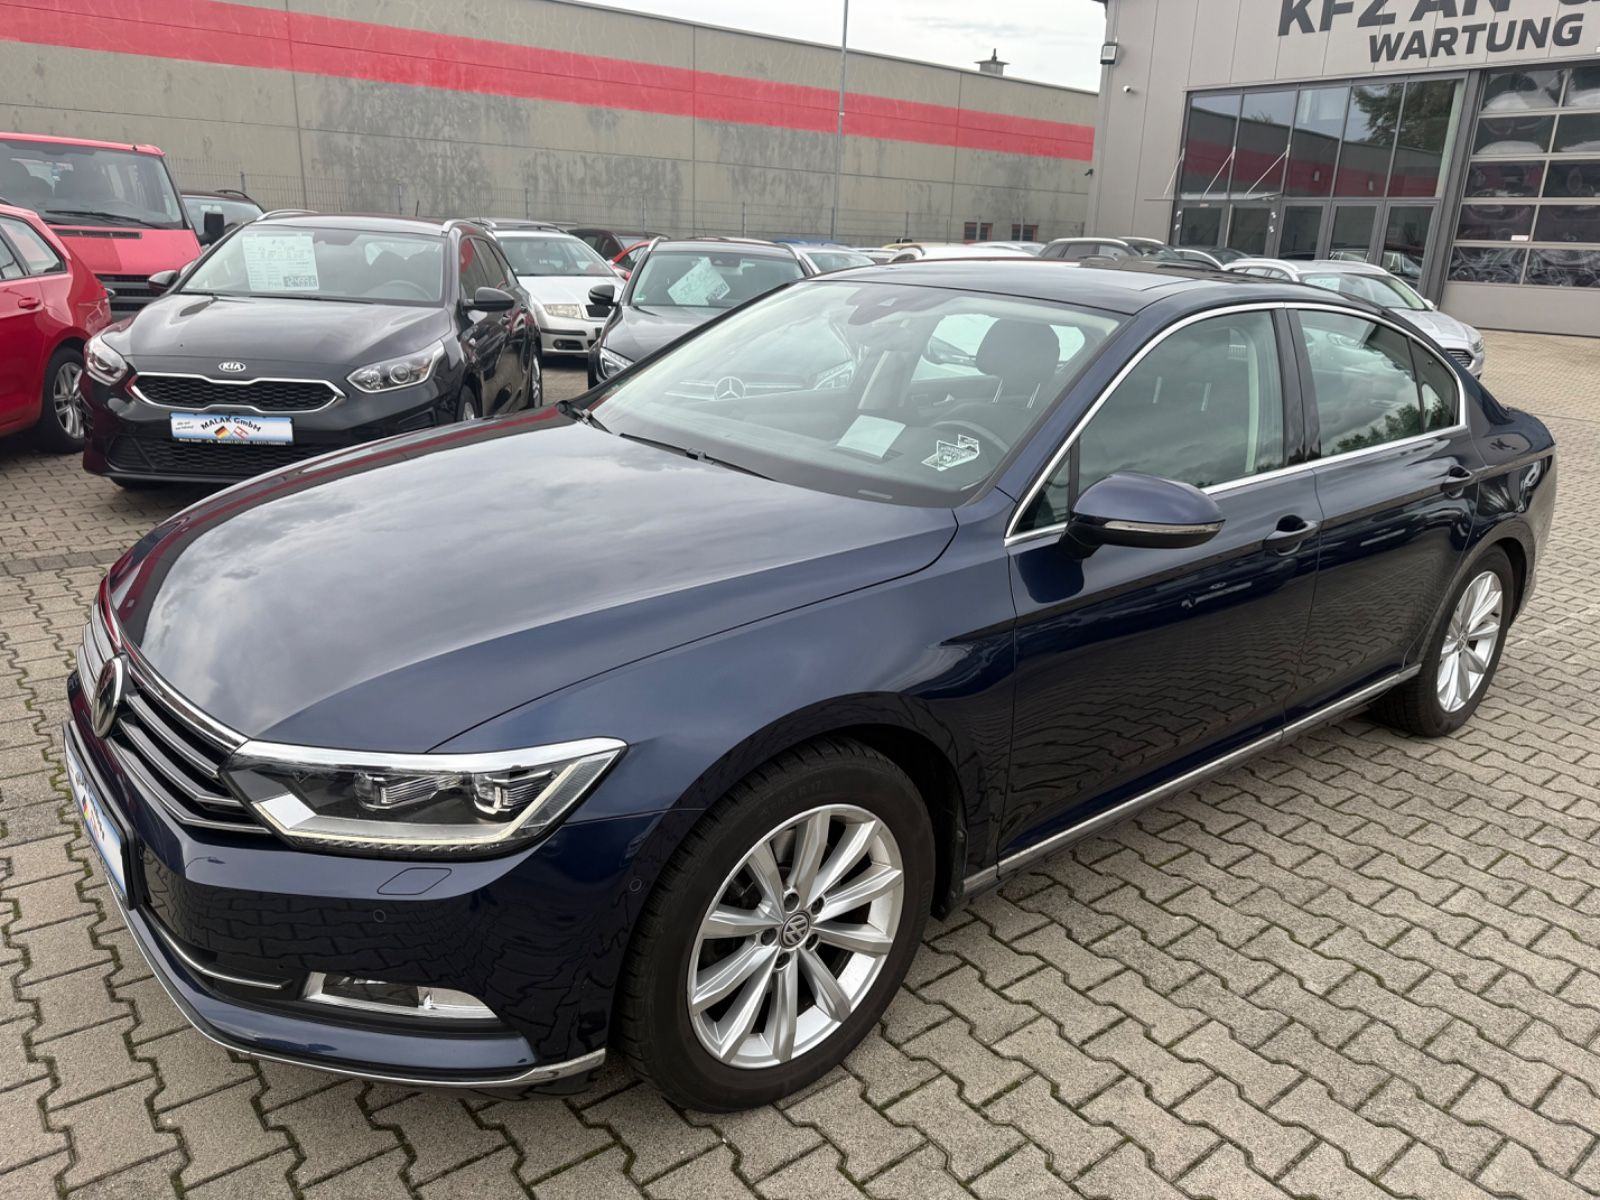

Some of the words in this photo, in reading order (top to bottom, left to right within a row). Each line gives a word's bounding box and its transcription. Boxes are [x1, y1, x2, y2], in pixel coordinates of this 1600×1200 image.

[1277, 0, 1396, 36] KFZ
[1369, 13, 1583, 63] WARTUNG
[221, 361, 243, 371] KIA
[200, 416, 231, 430] MALAK
